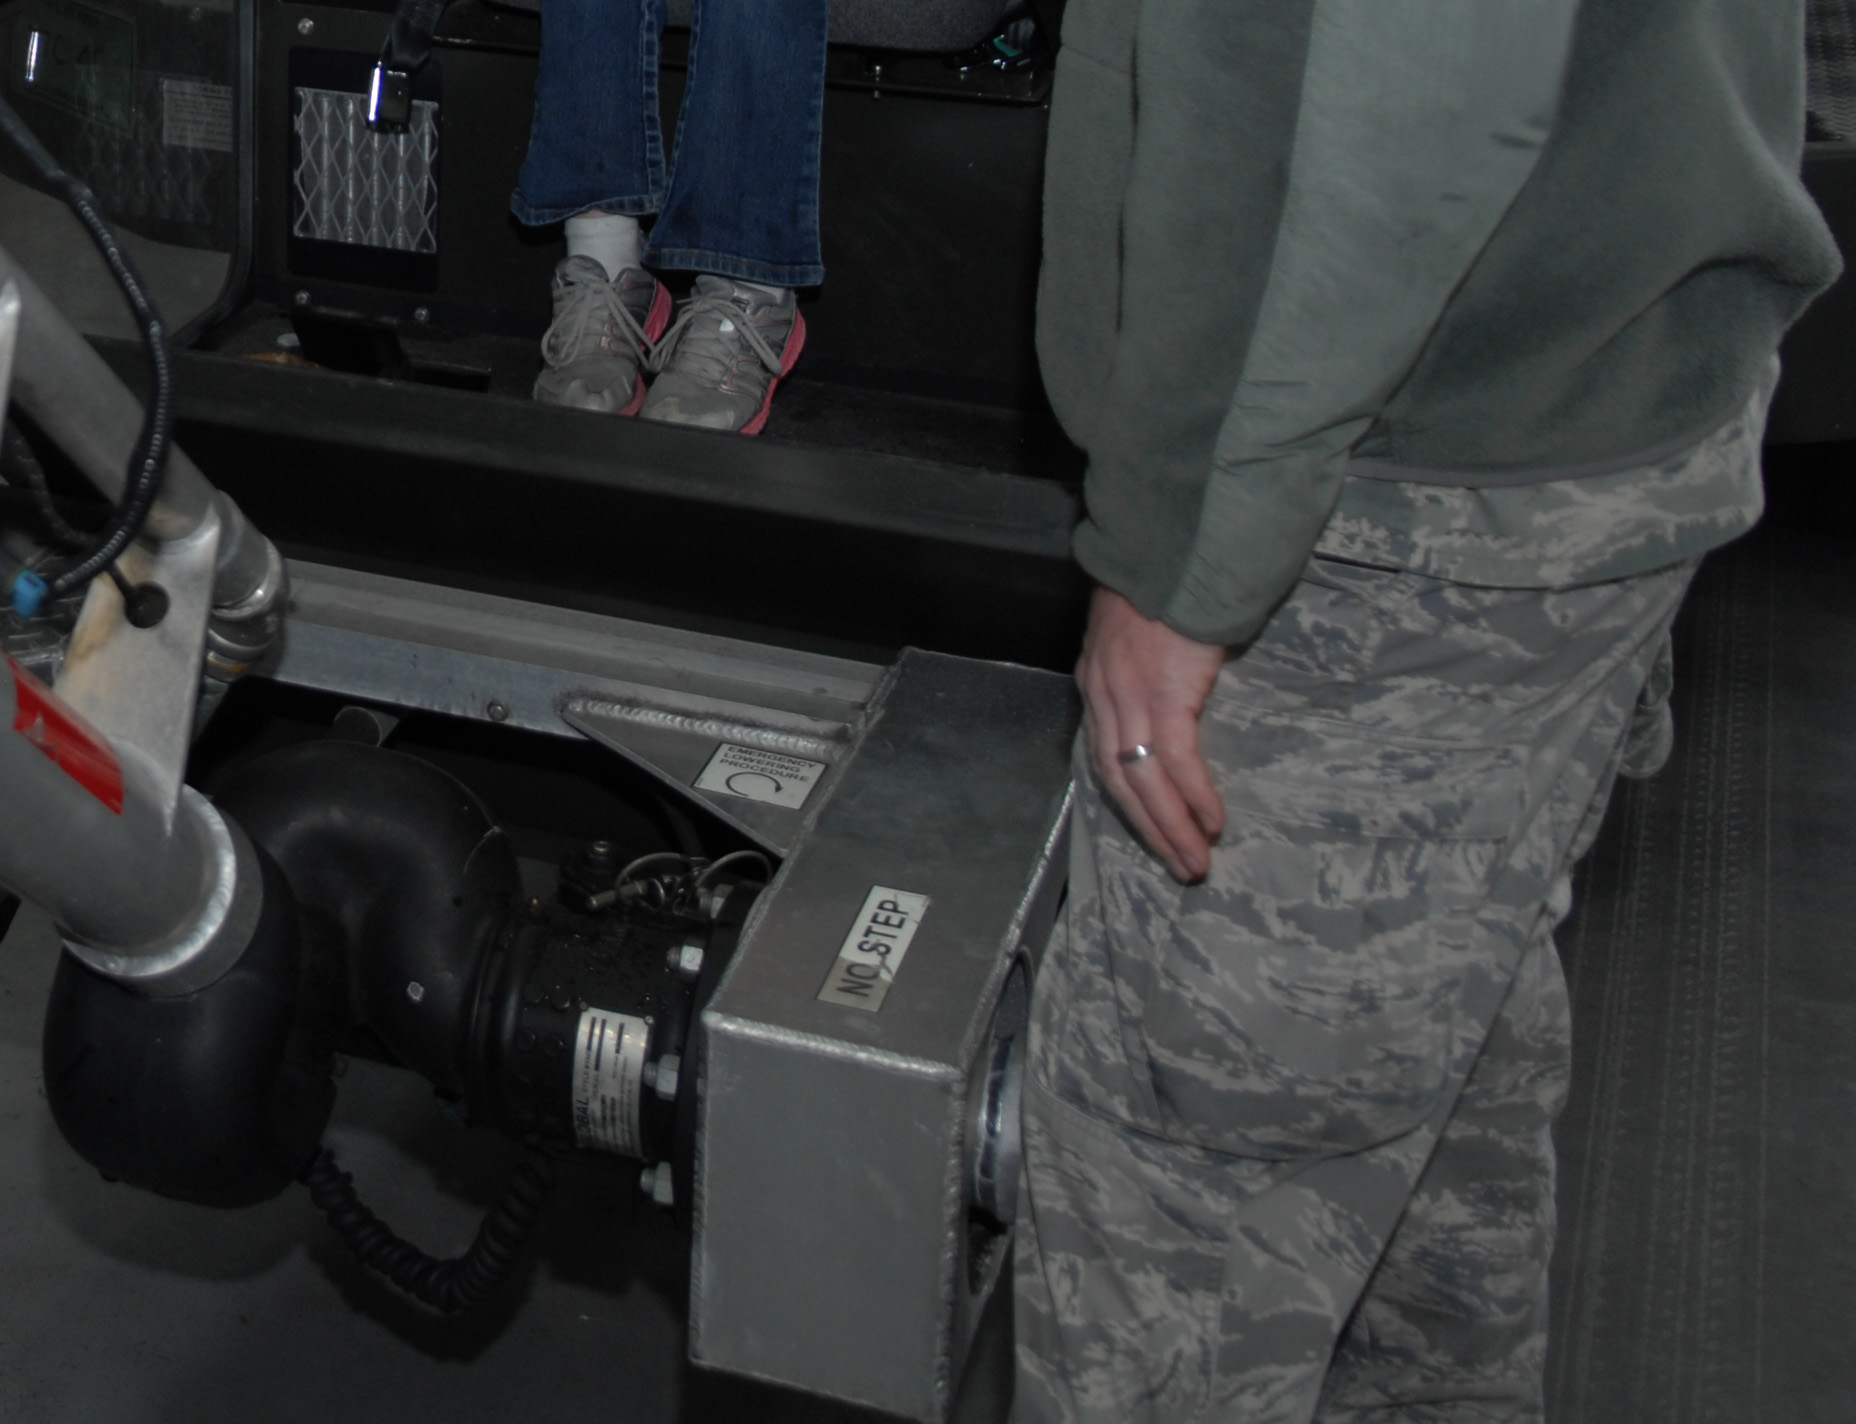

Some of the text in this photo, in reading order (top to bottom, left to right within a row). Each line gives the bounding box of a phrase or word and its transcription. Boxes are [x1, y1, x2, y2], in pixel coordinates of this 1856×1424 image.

[724, 752, 800, 773] LOWERING
[728, 746, 816, 769] EMERGENCY
[719, 758, 809, 783] PROCEDURE
[836, 900, 909, 997] NO STEP
